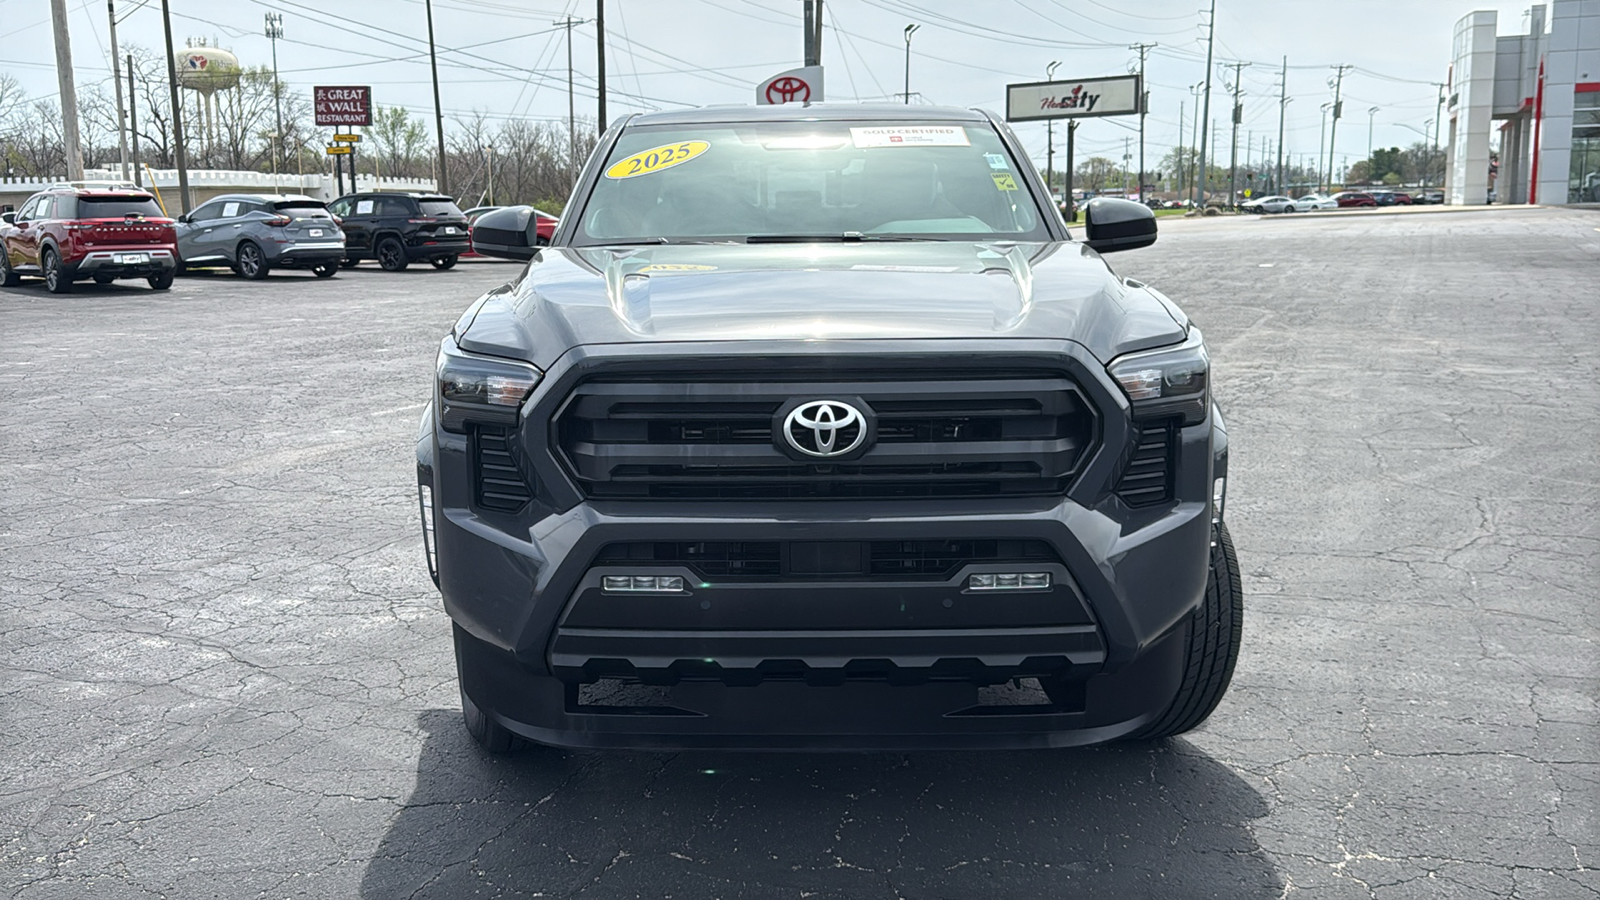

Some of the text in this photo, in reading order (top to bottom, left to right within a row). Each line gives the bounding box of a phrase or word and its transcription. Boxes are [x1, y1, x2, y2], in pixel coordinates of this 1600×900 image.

[327, 89, 364, 100] GREAT
[328, 102, 363, 112] WALL
[627, 143, 690, 175] 2025
